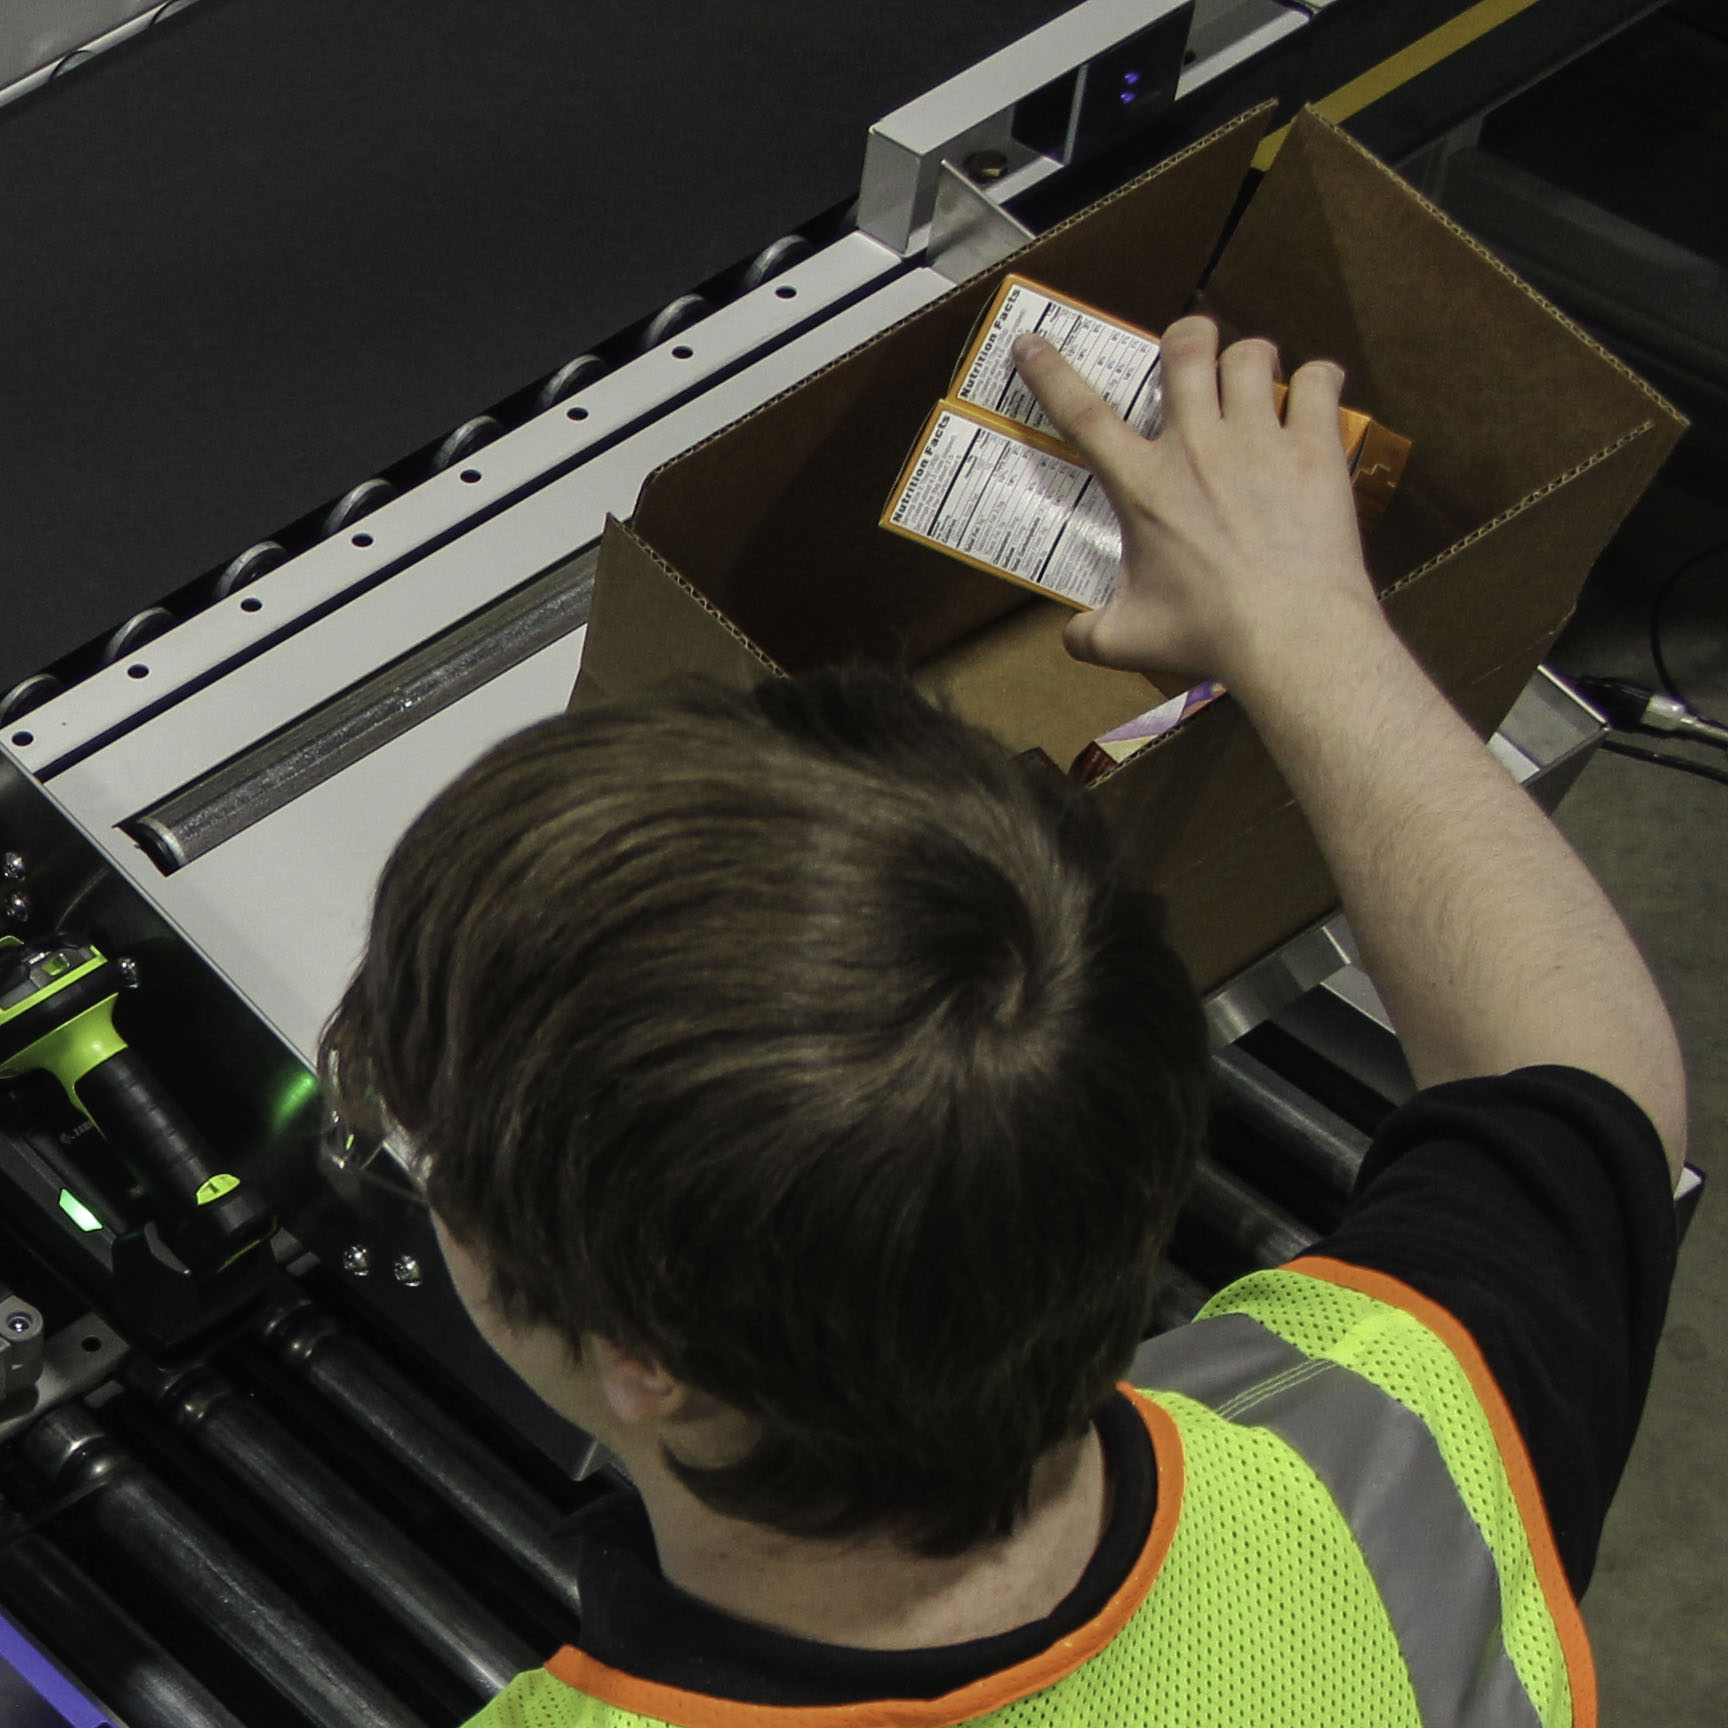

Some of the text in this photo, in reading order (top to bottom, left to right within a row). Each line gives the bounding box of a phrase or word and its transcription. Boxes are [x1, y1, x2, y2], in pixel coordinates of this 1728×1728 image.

[960, 288, 1021, 399] Nutrition Facts
[893, 415, 951, 523] Nutrition Facts
